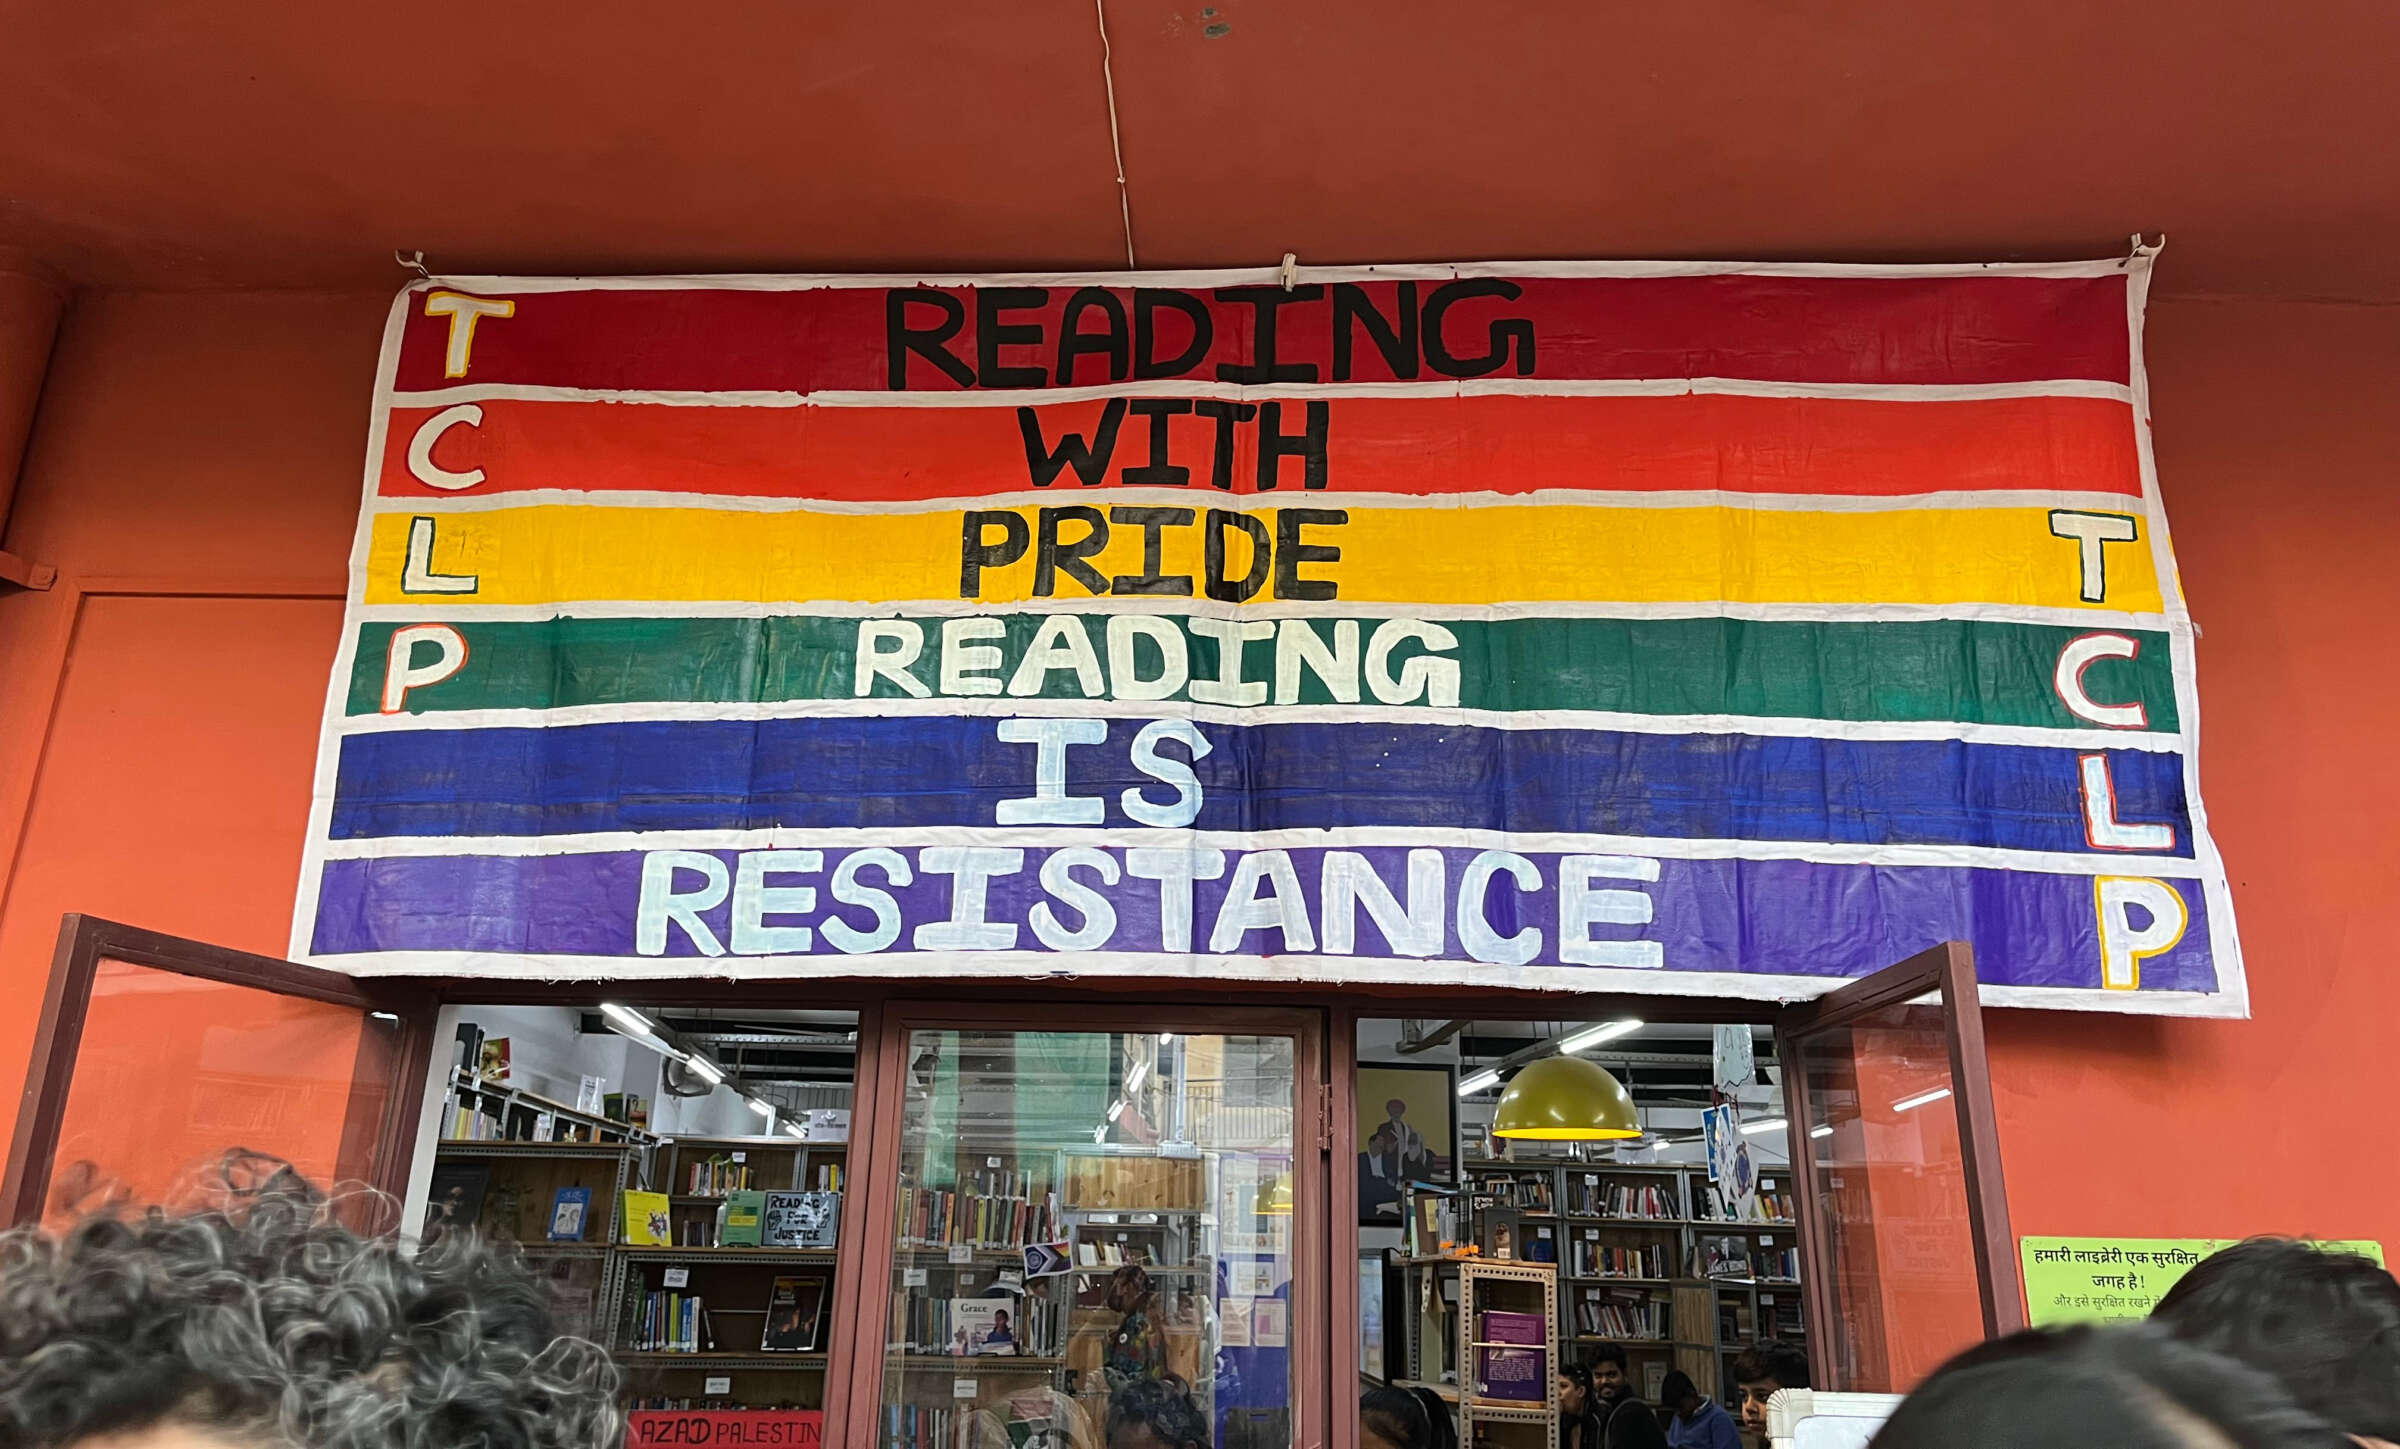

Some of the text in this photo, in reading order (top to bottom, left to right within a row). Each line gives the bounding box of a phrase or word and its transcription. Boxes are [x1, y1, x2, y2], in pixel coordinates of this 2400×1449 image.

[886, 277, 1536, 391] READING
[1017, 397, 1330, 491] WITH
[960, 505, 1349, 604] PRIDE
[854, 614, 1461, 708] READING
[995, 718, 1213, 828] IS
[636, 847, 1664, 969] RESISTANCE
[771, 1195, 820, 1209] READG
[775, 1227, 819, 1241] JUSTICE
[2034, 1246, 2199, 1268] हमारी लाइब्रेरी एक सुरक्षित
[2092, 1275, 2125, 1289] जगह
[961, 1303, 988, 1313] Grace
[2054, 1294, 2071, 1307] और
[2093, 1295, 2125, 1310] सुरक्षित
[640, 1418, 711, 1444] AZAD
